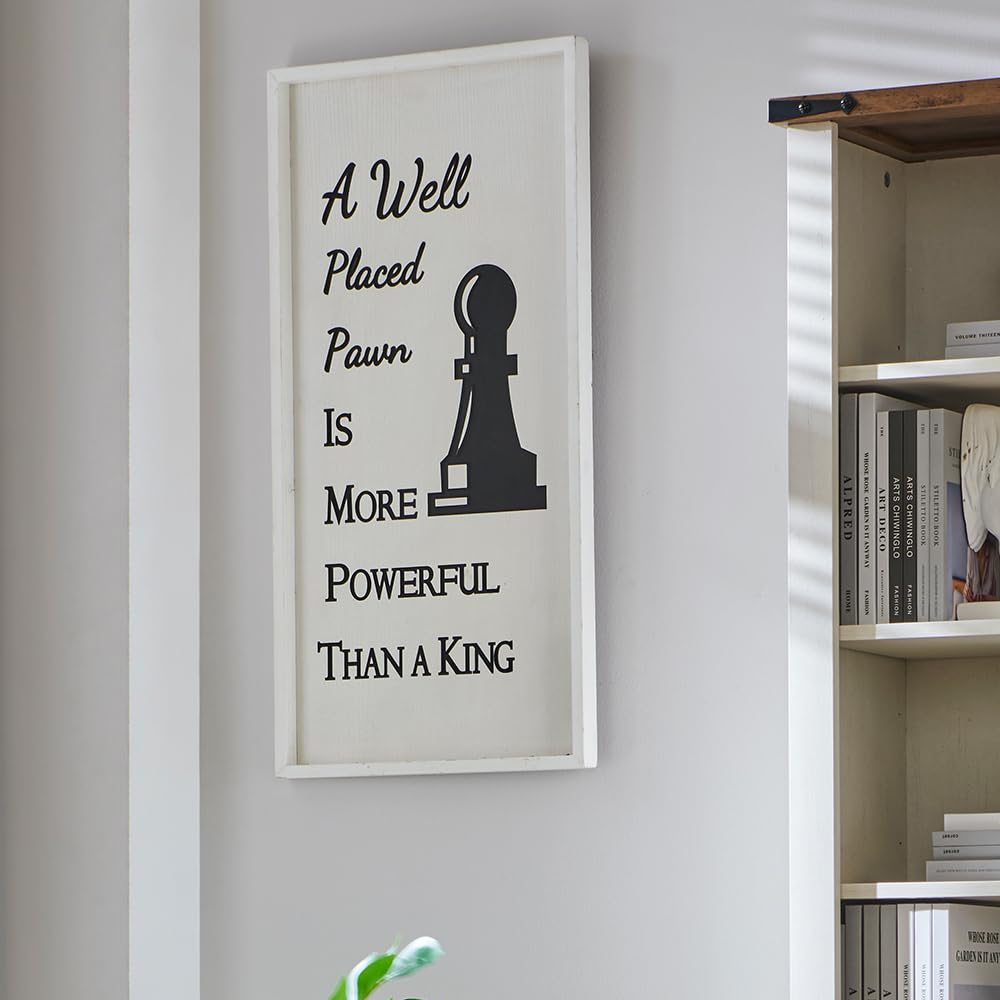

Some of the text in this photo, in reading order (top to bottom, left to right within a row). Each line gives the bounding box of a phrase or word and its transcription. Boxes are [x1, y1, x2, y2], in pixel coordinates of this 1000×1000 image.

[321, 152, 472, 225] A Well
[323, 241, 426, 295] Placed
[323, 326, 412, 373] Pawn
[844, 475, 853, 541] ALPRED
[878, 487, 886, 512] ART
[906, 476, 914, 502] ARTS
[878, 518, 886, 552] DECO
[906, 504, 914, 558] CHIWINGLO
[956, 950, 976, 962] GARDEN
[968, 931, 1000, 944] WHOSE ROSE
